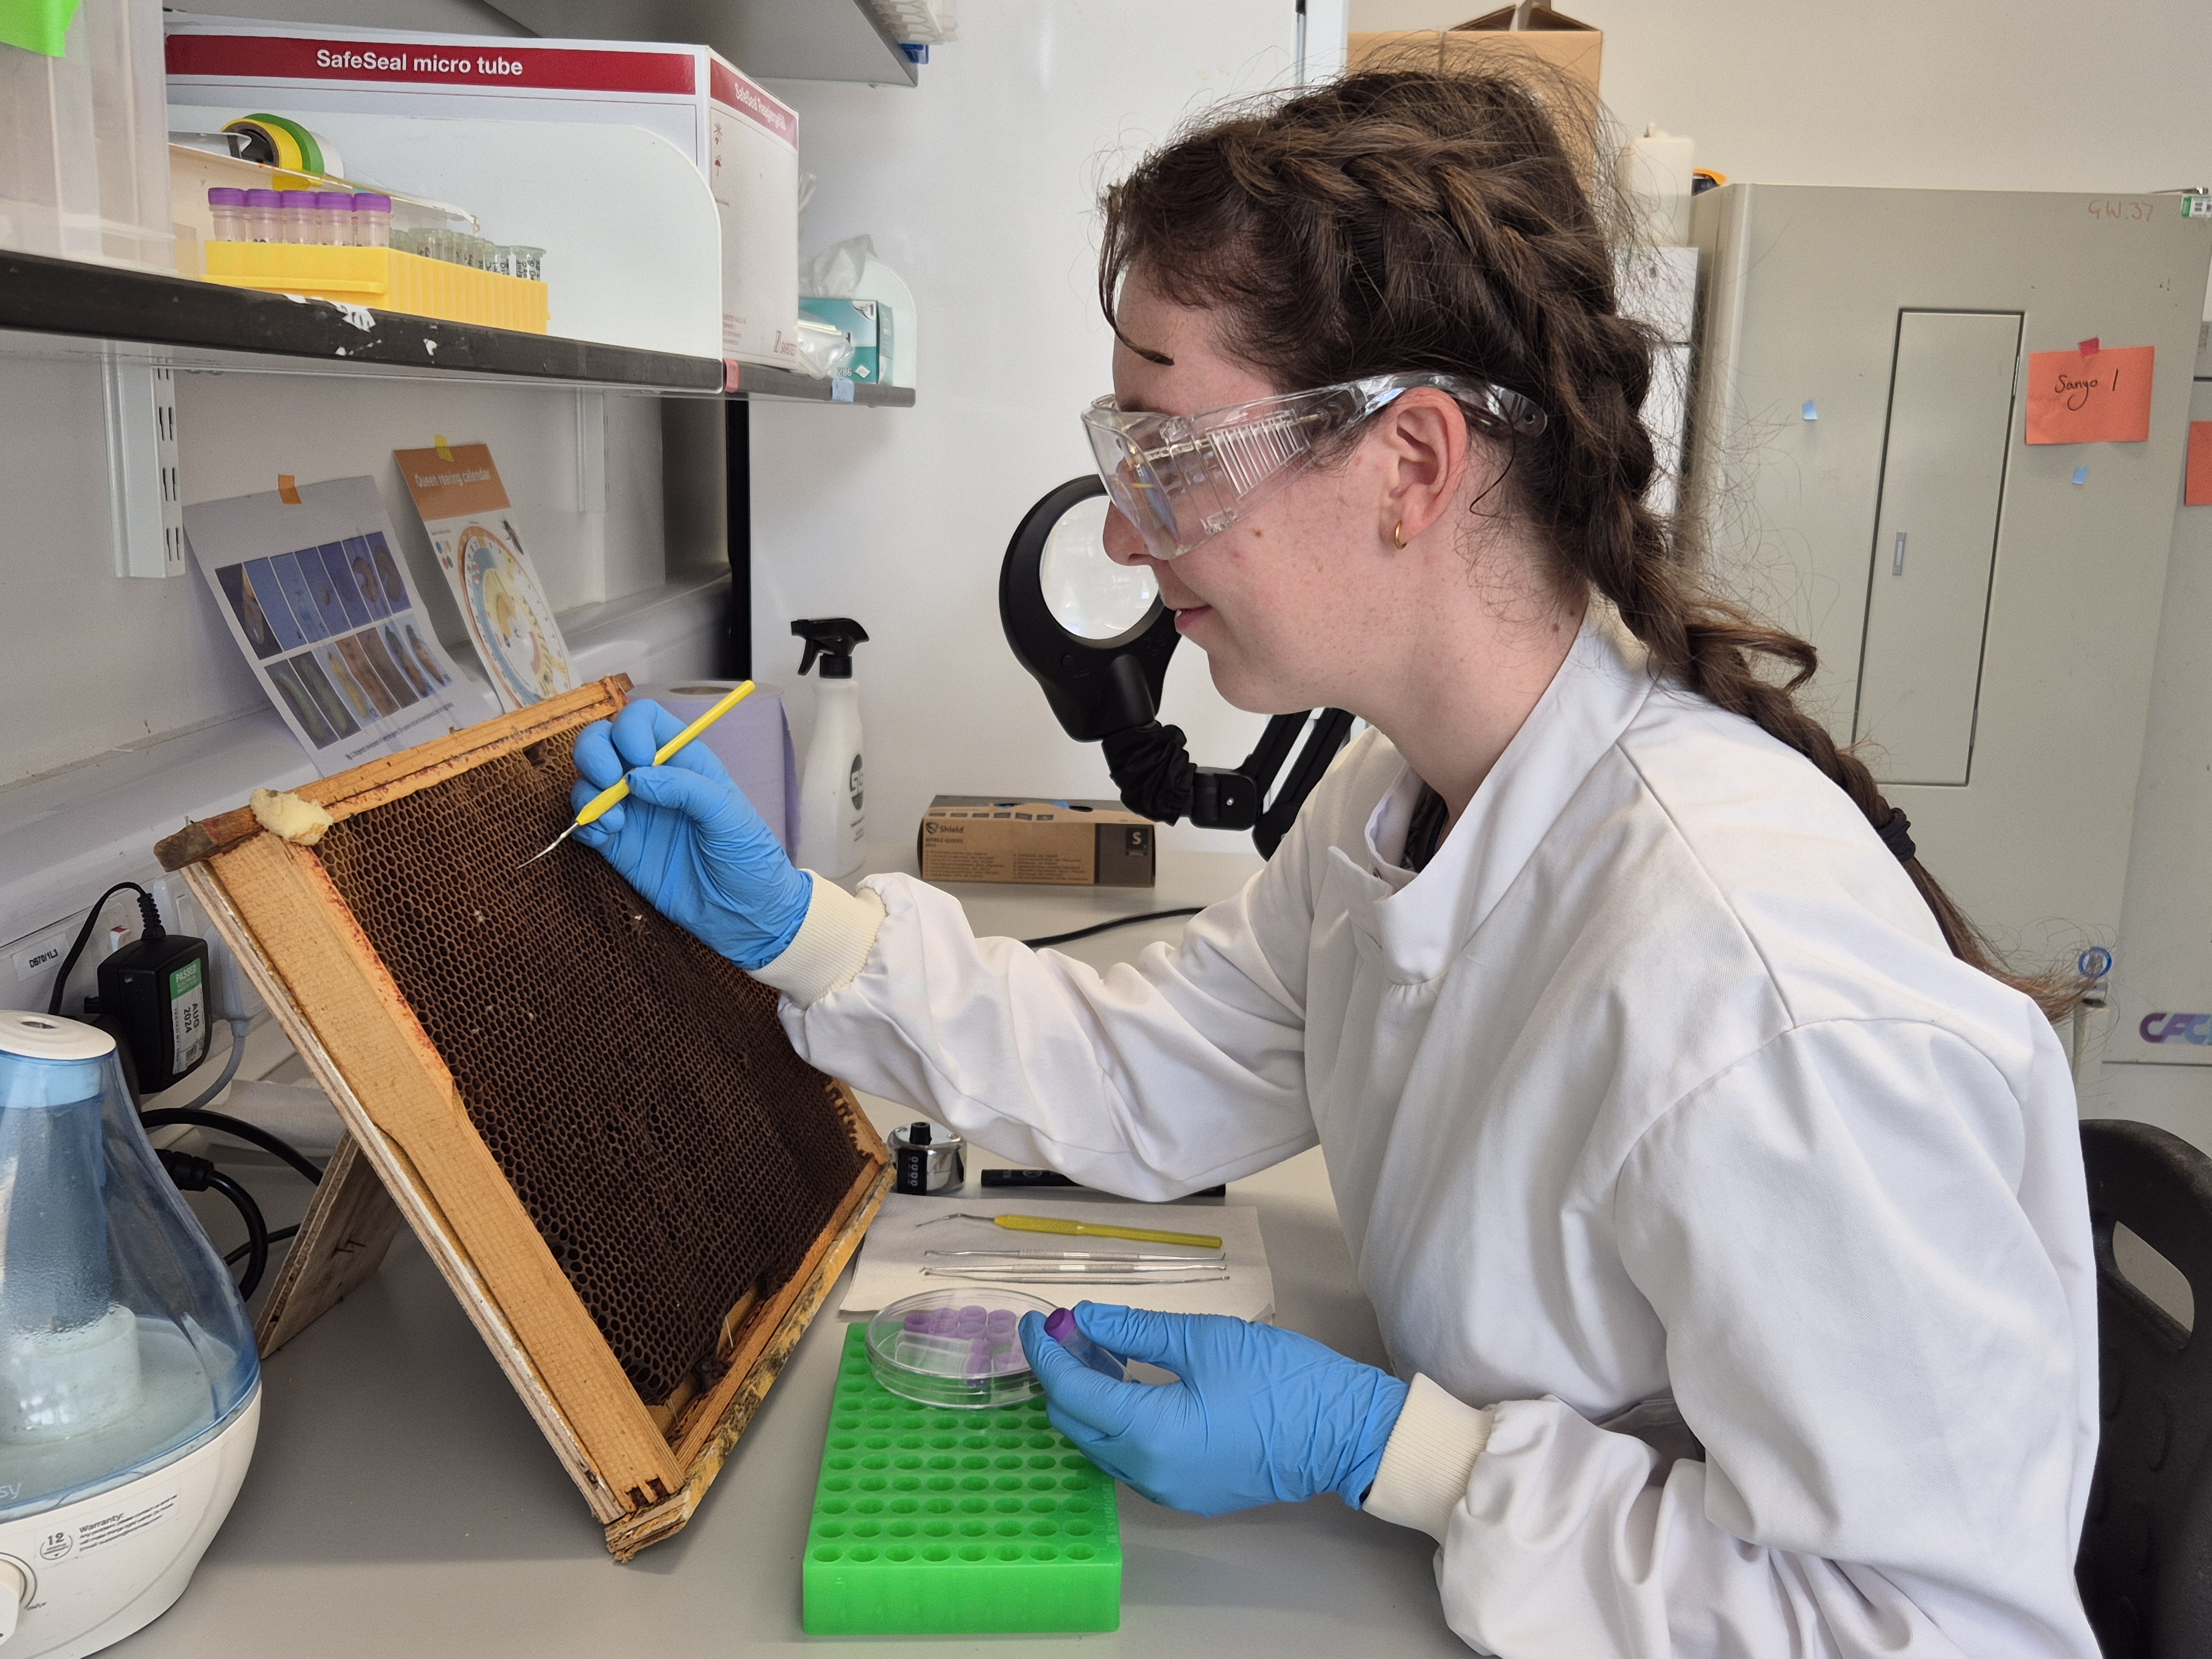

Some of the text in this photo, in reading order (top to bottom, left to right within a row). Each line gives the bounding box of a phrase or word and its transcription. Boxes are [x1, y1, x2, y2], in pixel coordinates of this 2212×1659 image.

[316, 49, 523, 76] SafeSeal micro tube
[2054, 374, 2098, 411] Sanyo
[1132, 831, 1141, 845] S
[184, 1006, 192, 1034] 2024
[48, 1532, 64, 1546] 12
